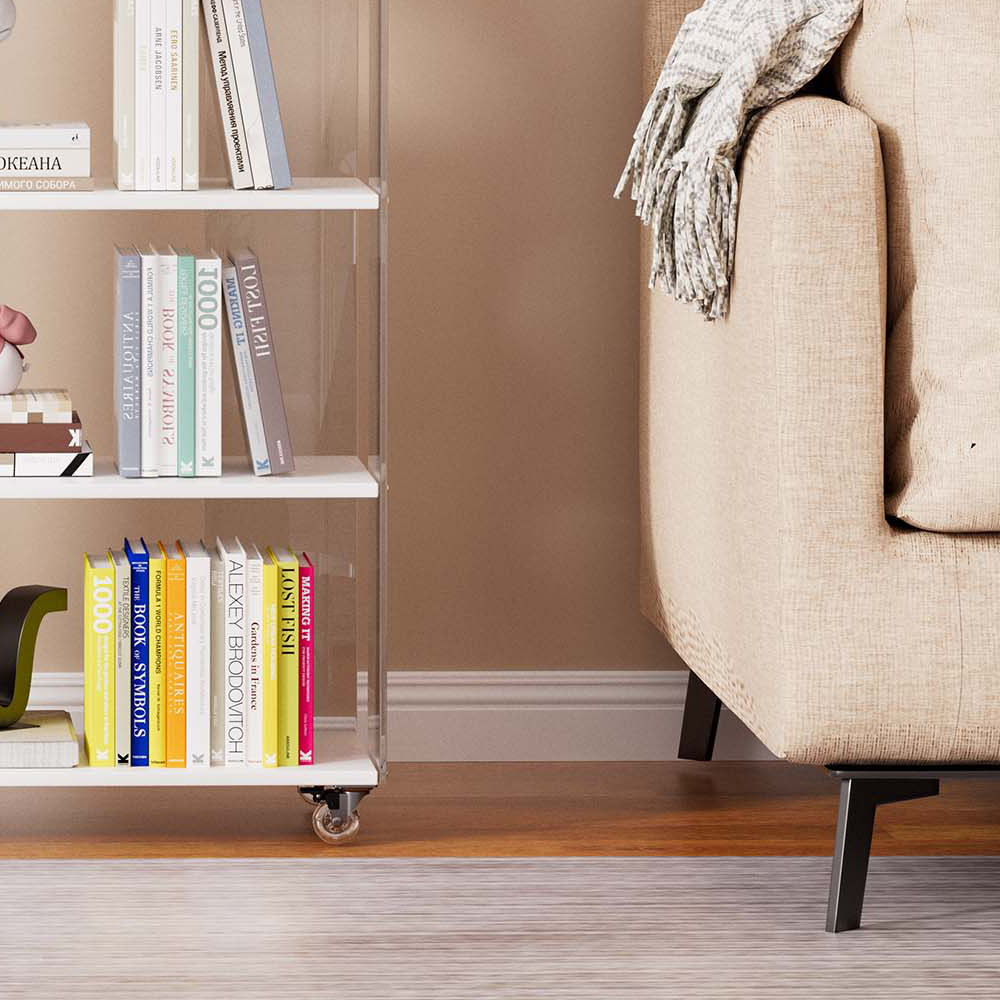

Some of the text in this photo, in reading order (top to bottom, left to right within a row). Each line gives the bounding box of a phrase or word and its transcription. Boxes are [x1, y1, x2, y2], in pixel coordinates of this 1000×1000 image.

[154, 27, 162, 90] ARNE JACOBSEN
[170, 29, 178, 91] EERO SAARINEN
[218, 51, 246, 173] Метод управления проектами
[35, 180, 76, 190] СОБОРА
[93, 575, 112, 633] 1000
[122, 576, 130, 639] TEXTILE DESIGNERS
[134, 604, 146, 646] BOOK
[281, 568, 295, 655] LOST FISH
[301, 576, 311, 641] MAKING IT
[134, 650, 141, 660] OF
[173, 612, 184, 715] ANTIQUAIRES
[228, 560, 243, 754] ALEXEY BRODOVITCH
[250, 622, 260, 711] Gardens in France
[134, 663, 146, 738] SYMBOLS
